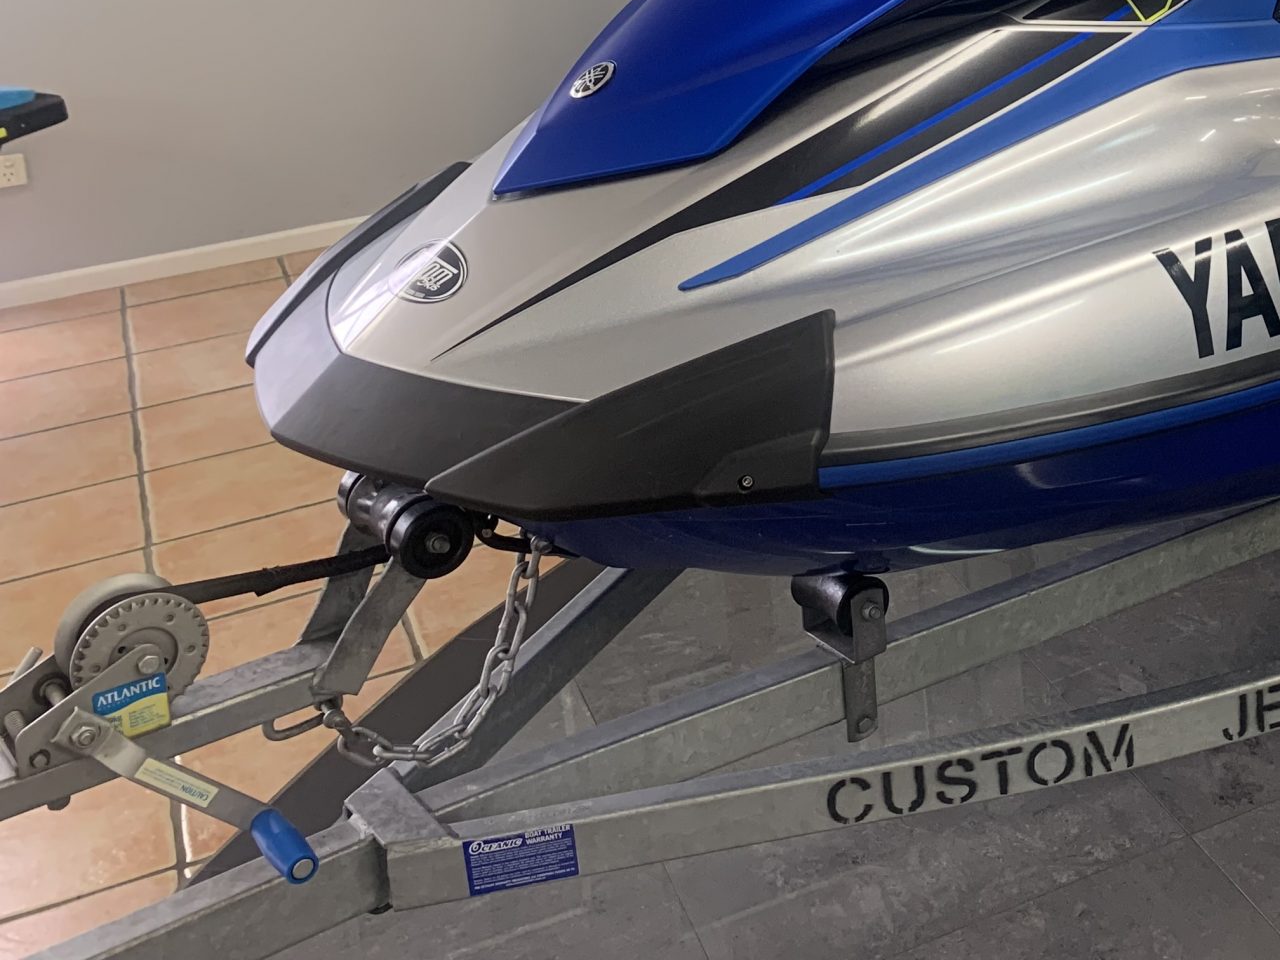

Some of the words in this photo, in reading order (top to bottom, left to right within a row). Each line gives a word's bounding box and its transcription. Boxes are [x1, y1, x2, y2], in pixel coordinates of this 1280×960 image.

[97, 676, 160, 708] ATLANTIC
[827, 723, 1136, 825] CUSTOM
[181, 784, 209, 801] CAUTION
[525, 829, 543, 839] BOAT
[544, 824, 571, 836] TRAILER
[526, 832, 563, 845] WARRANTY
[469, 838, 523, 855] OCEANIC
